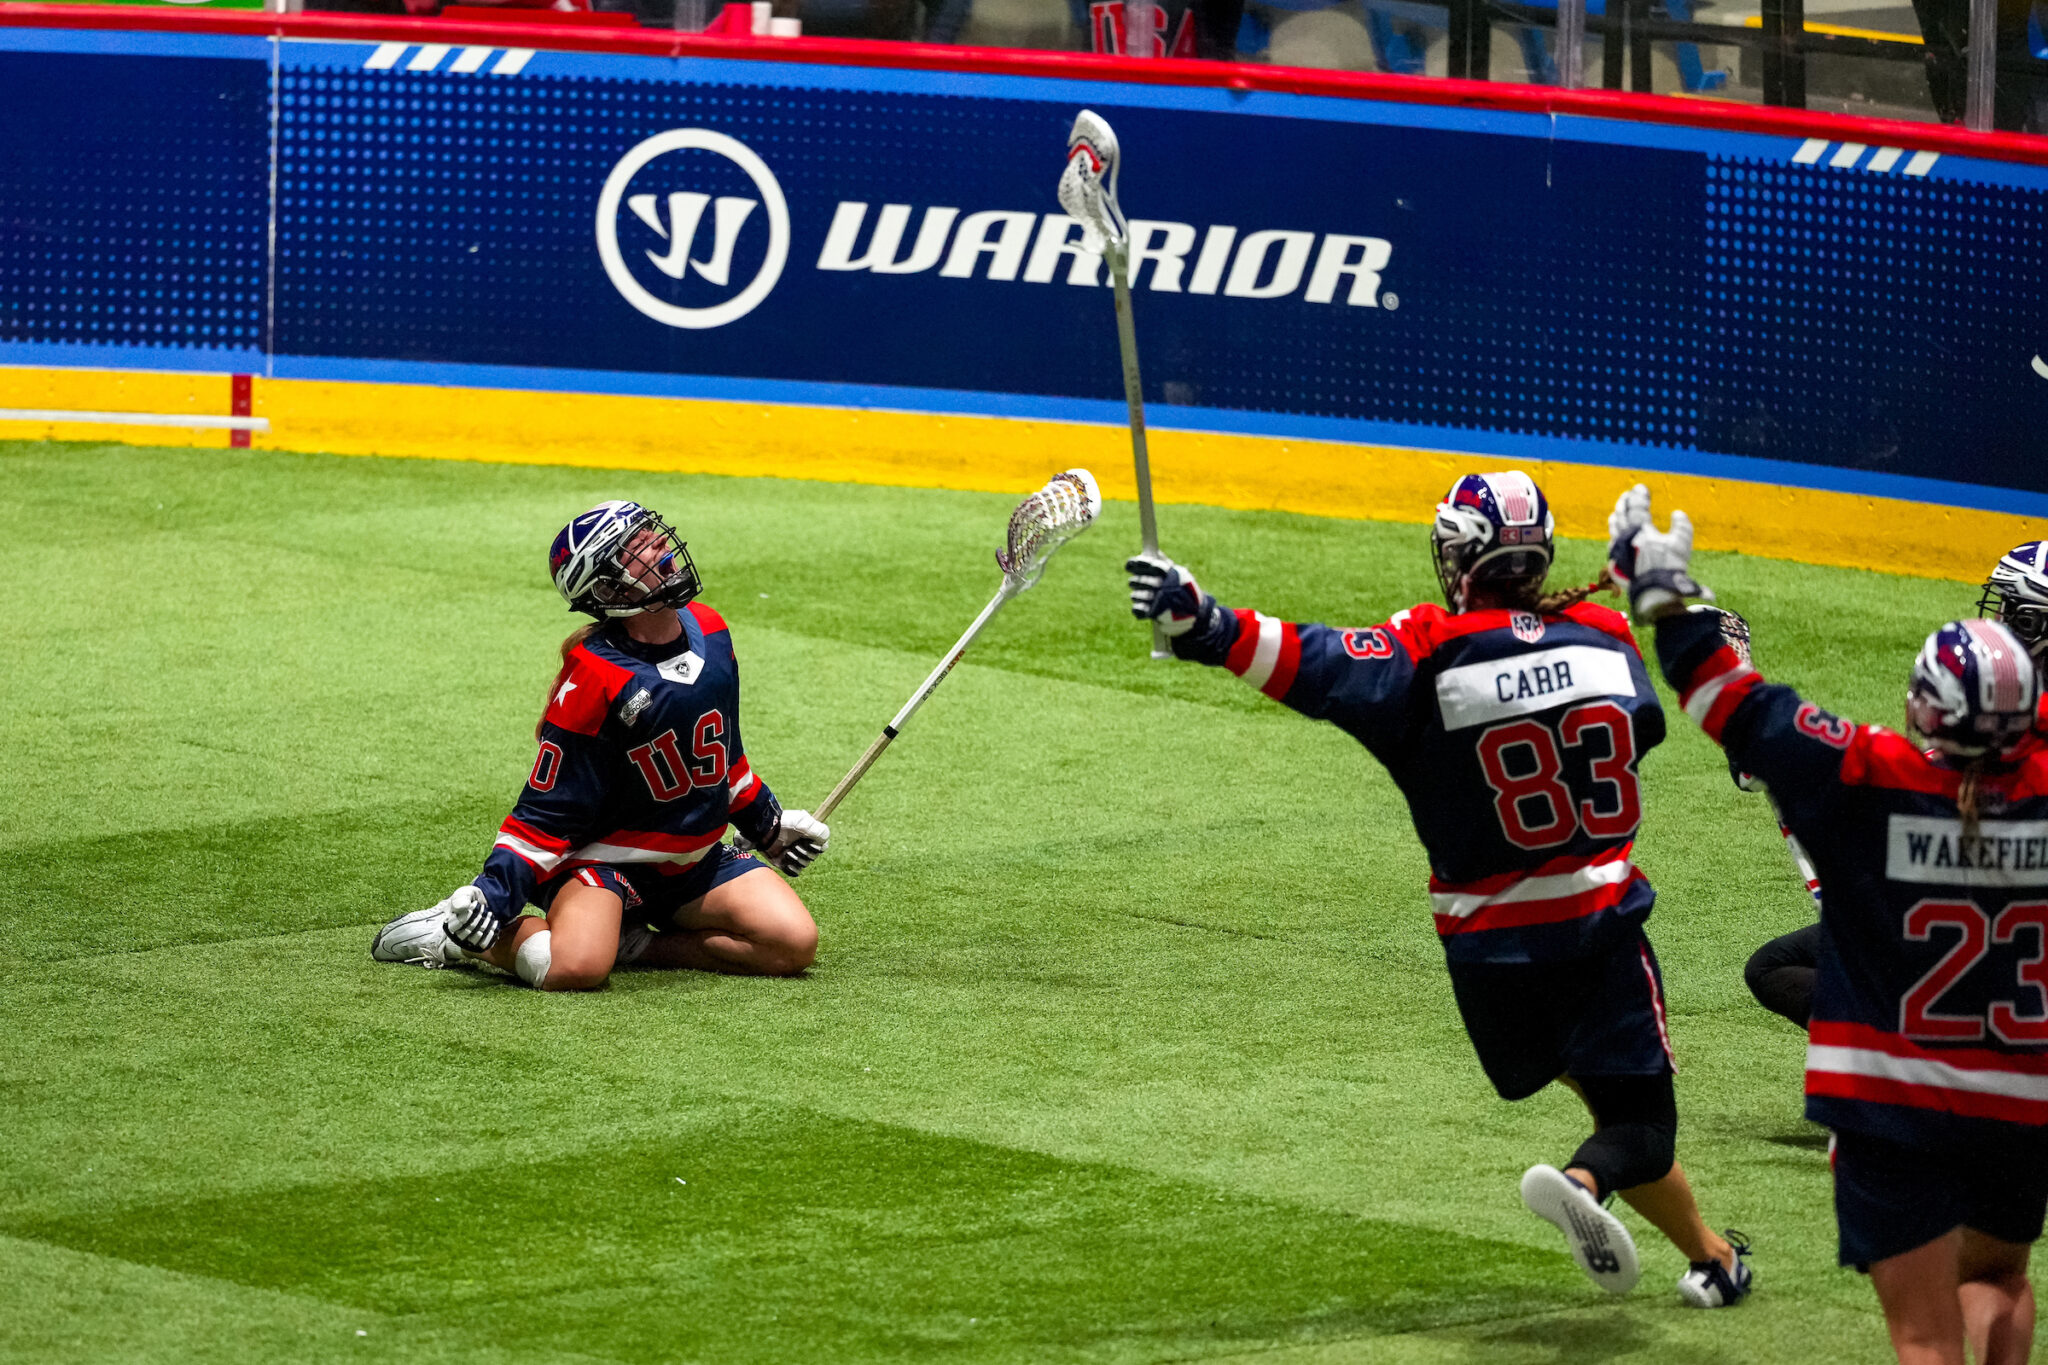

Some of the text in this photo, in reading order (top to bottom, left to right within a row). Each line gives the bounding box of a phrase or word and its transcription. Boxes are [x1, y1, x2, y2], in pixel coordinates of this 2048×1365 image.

[1496, 660, 1575, 702] CARR
[1793, 702, 1856, 749] 3
[626, 708, 729, 802] US
[1476, 700, 1643, 851] 83
[1899, 898, 2048, 1045] 23
